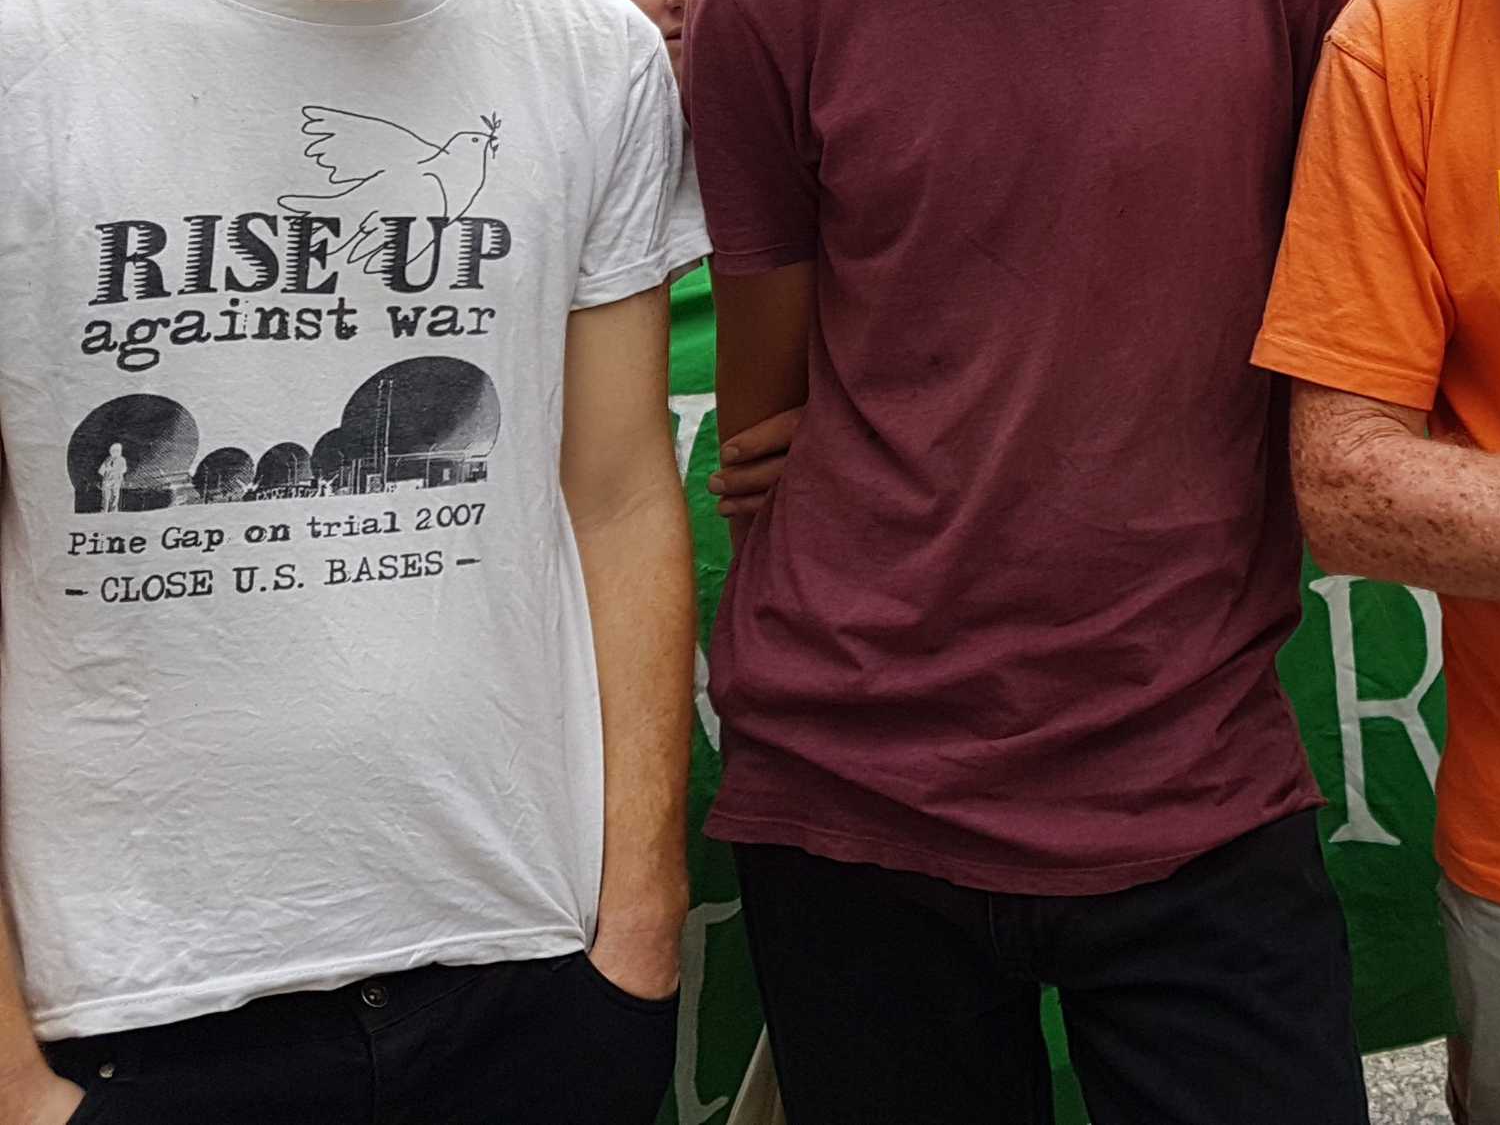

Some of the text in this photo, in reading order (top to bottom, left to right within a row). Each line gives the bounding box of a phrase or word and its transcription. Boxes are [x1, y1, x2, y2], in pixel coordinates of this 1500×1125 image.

[88, 211, 512, 307] RISE UP
[81, 296, 496, 373] against war
[67, 503, 487, 556] Pine Gap on trial 2007
[232, 563, 305, 595] U.S.
